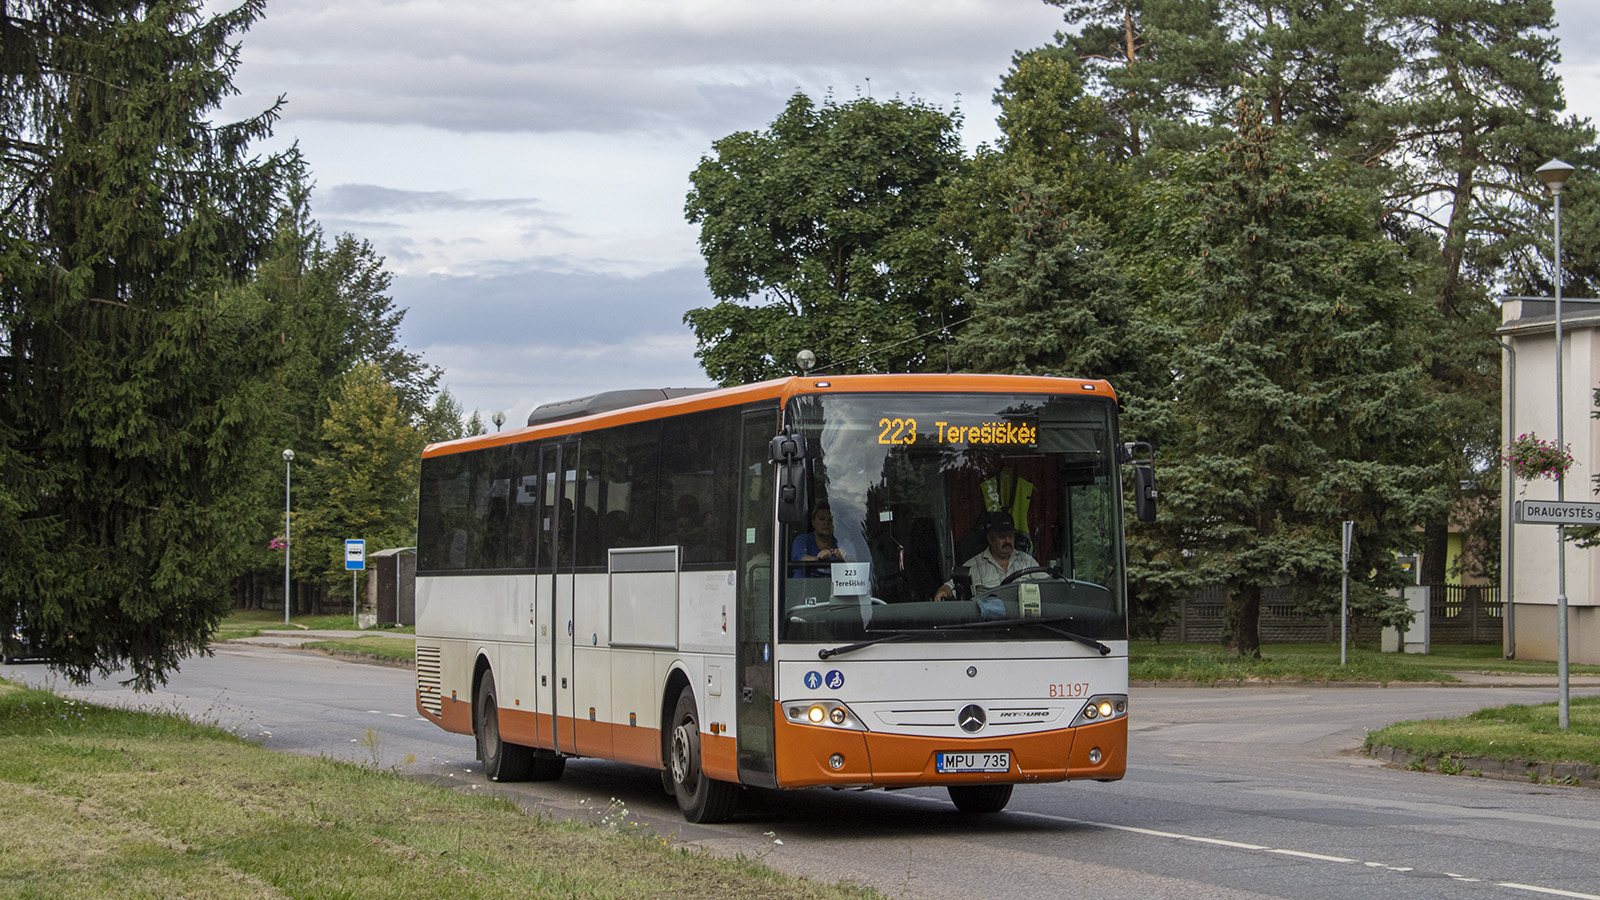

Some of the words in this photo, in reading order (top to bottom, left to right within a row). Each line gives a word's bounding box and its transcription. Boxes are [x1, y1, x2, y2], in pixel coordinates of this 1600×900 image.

[878, 418, 917, 445] 223
[1527, 506, 1594, 519] DRAUGYSTĖS
[844, 569, 857, 577] 223
[1049, 683, 1090, 698] B1197
[945, 755, 975, 768] MPU
[983, 754, 1007, 768] 735
